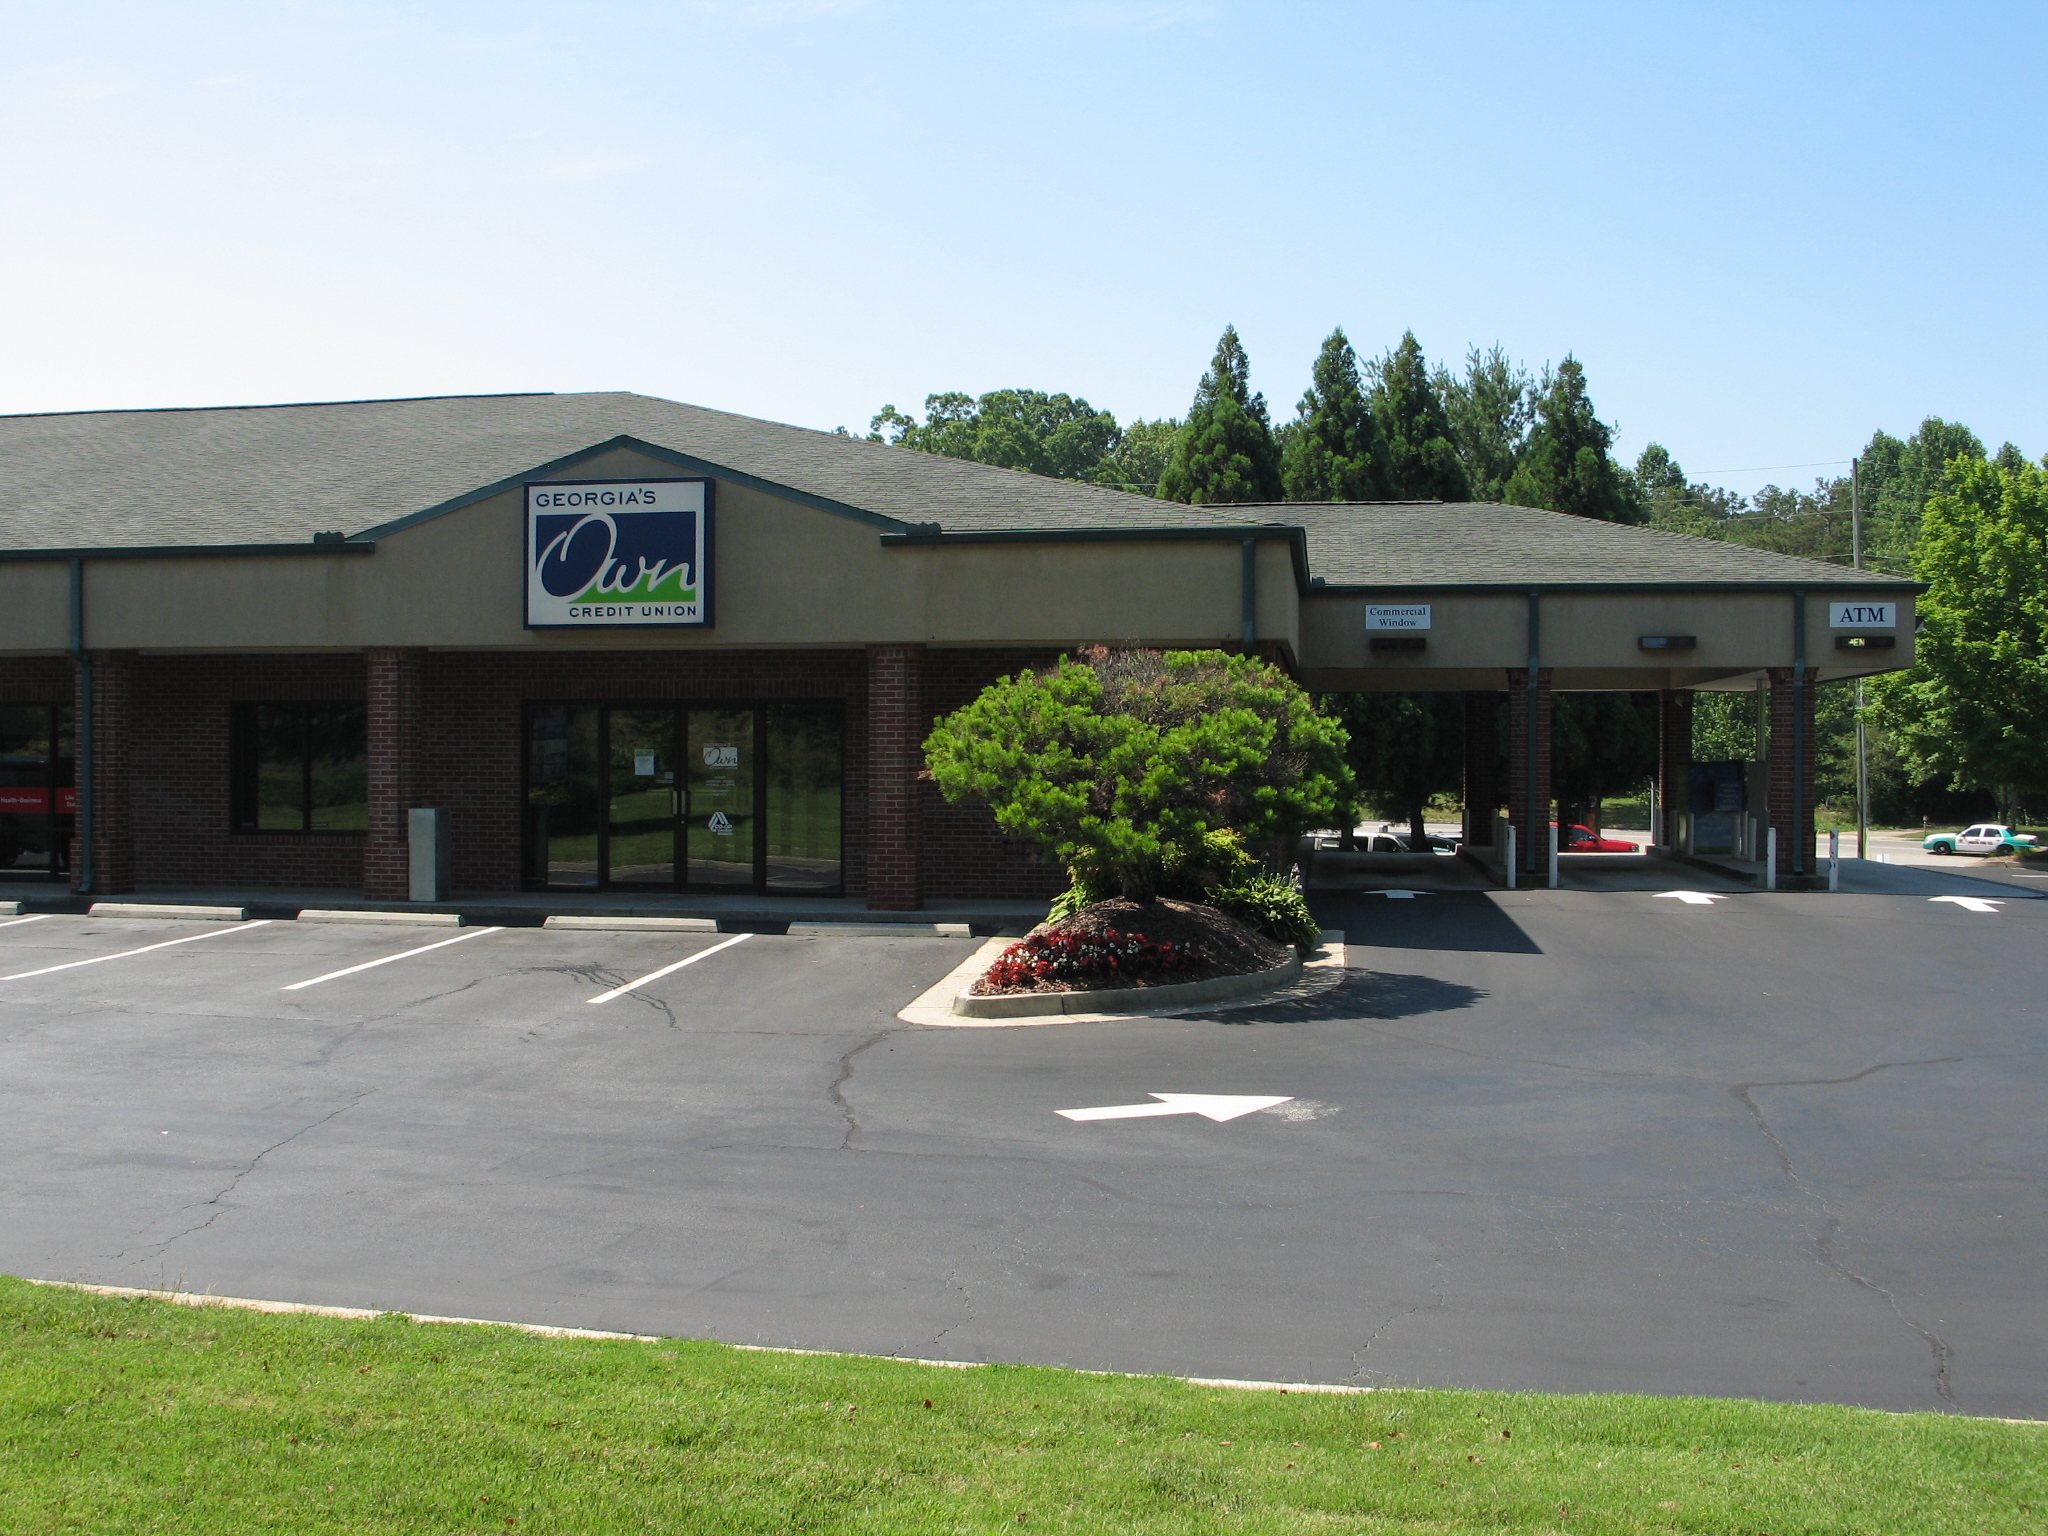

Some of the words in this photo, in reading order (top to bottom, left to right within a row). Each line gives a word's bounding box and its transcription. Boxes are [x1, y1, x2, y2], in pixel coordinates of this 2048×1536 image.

[535, 488, 657, 507] GEORGIA'S
[535, 512, 697, 600] Own
[568, 606, 634, 618] CREDIT
[641, 605, 697, 617] UNION
[1369, 607, 1426, 616] Commercial
[1840, 607, 1885, 623] ATM
[1378, 618, 1417, 627] Window
[703, 747, 738, 767] Own
